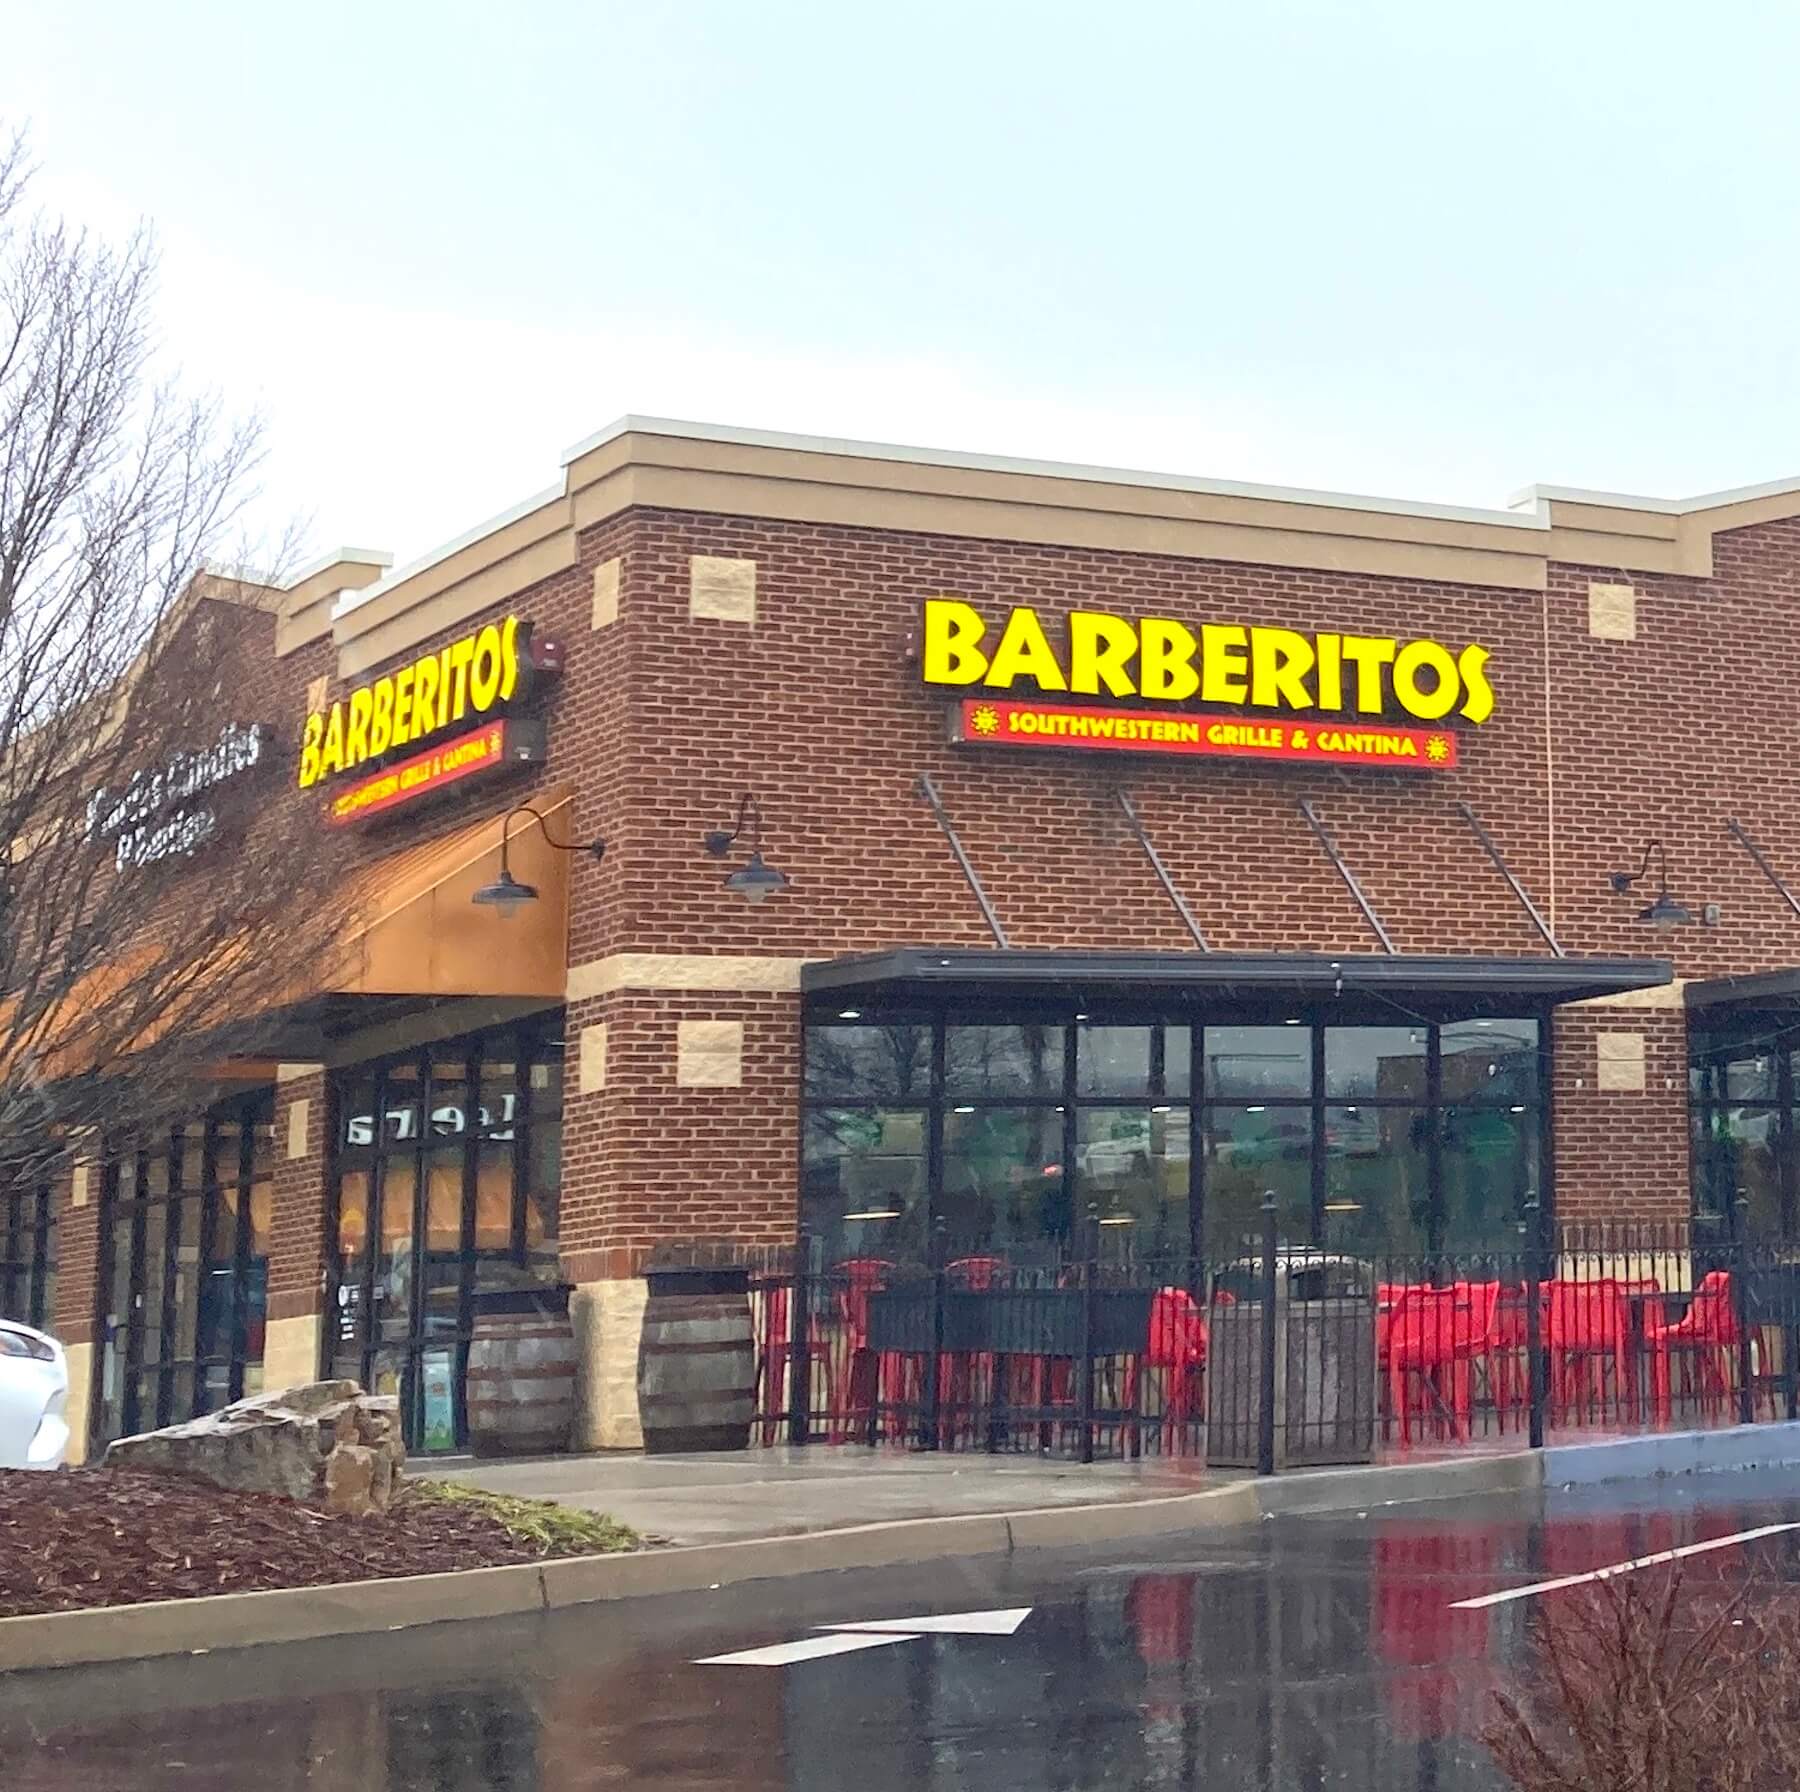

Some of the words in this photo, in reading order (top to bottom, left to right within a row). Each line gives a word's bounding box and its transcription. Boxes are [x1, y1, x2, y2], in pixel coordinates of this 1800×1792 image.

[298, 614, 518, 790] BARBERITOS
[923, 599, 1495, 724] BARBERITOS
[1008, 711, 1200, 743] SOUTHWESTERN
[1206, 724, 1283, 748] GRILLE
[1291, 729, 1309, 750] &
[1316, 731, 1418, 757] CANTINA
